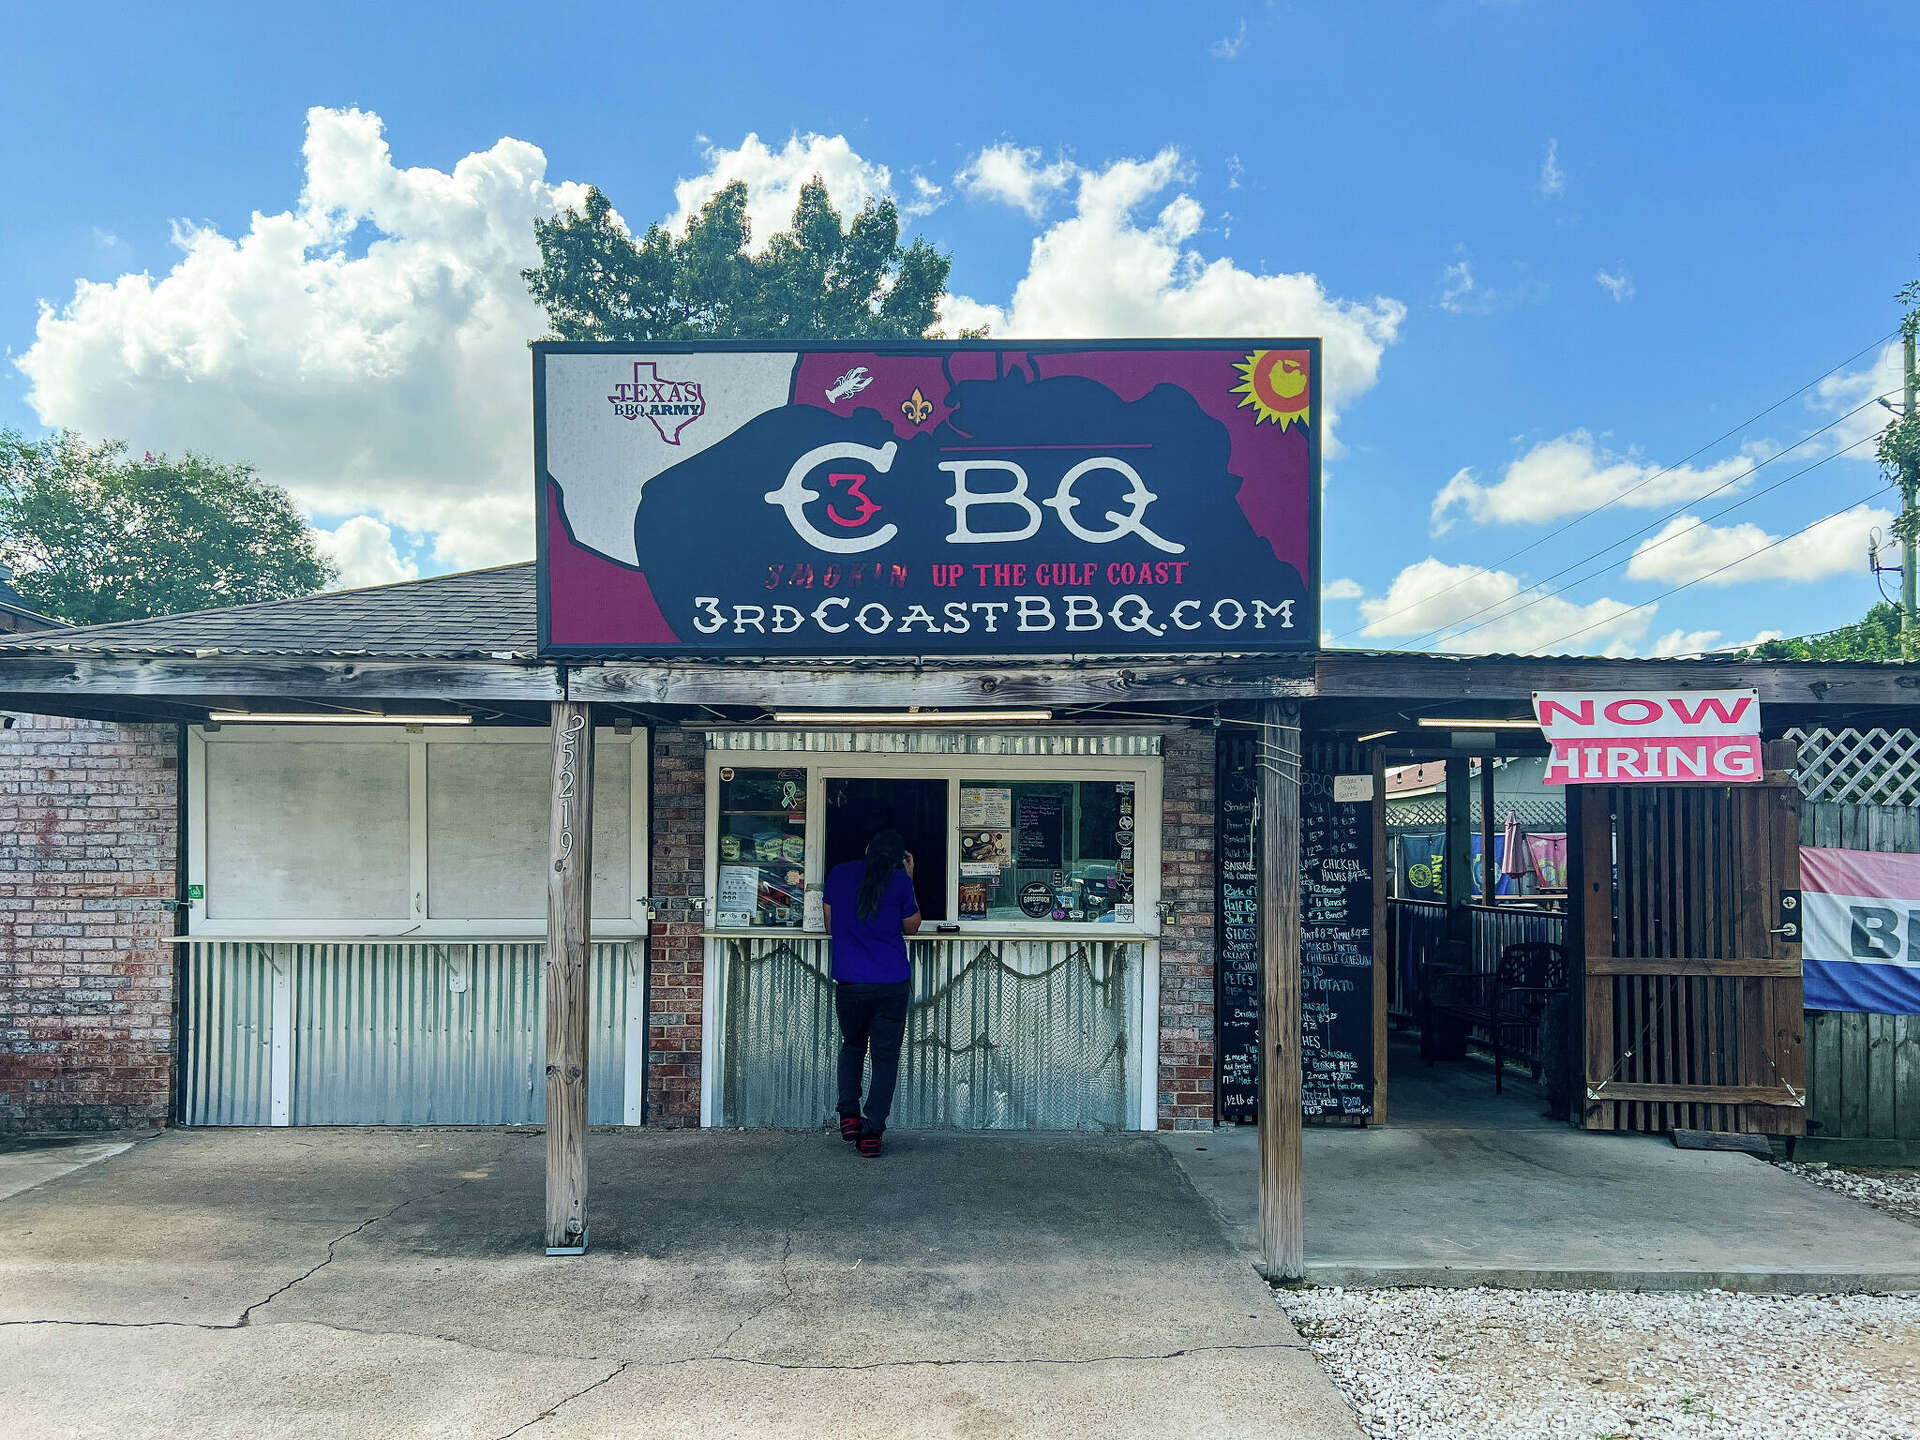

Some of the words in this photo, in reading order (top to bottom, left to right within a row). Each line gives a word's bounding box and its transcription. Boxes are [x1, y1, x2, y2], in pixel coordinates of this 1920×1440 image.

[615, 383, 698, 403] TEXAS
[614, 404, 645, 417] BBQ
[649, 404, 701, 416] ARMY
[827, 473, 883, 527] 3
[938, 457, 1186, 557] BQ
[932, 565, 964, 588] UP
[972, 564, 1027, 588] THE
[1036, 563, 1098, 587] GULF
[1106, 561, 1190, 586] COAST
[693, 594, 1296, 637] 3RDCOASTBBQ.COM
[1539, 698, 1752, 726] NOW
[1544, 745, 1754, 779] HIRING
[560, 714, 586, 860] 25219
[1223, 860, 1257, 871] SAUSAGE
[1322, 858, 1361, 870] CHICKEN
[1223, 898, 1244, 912] Half
[1225, 926, 1256, 940] SIDES
[1850, 905, 1920, 962] B
